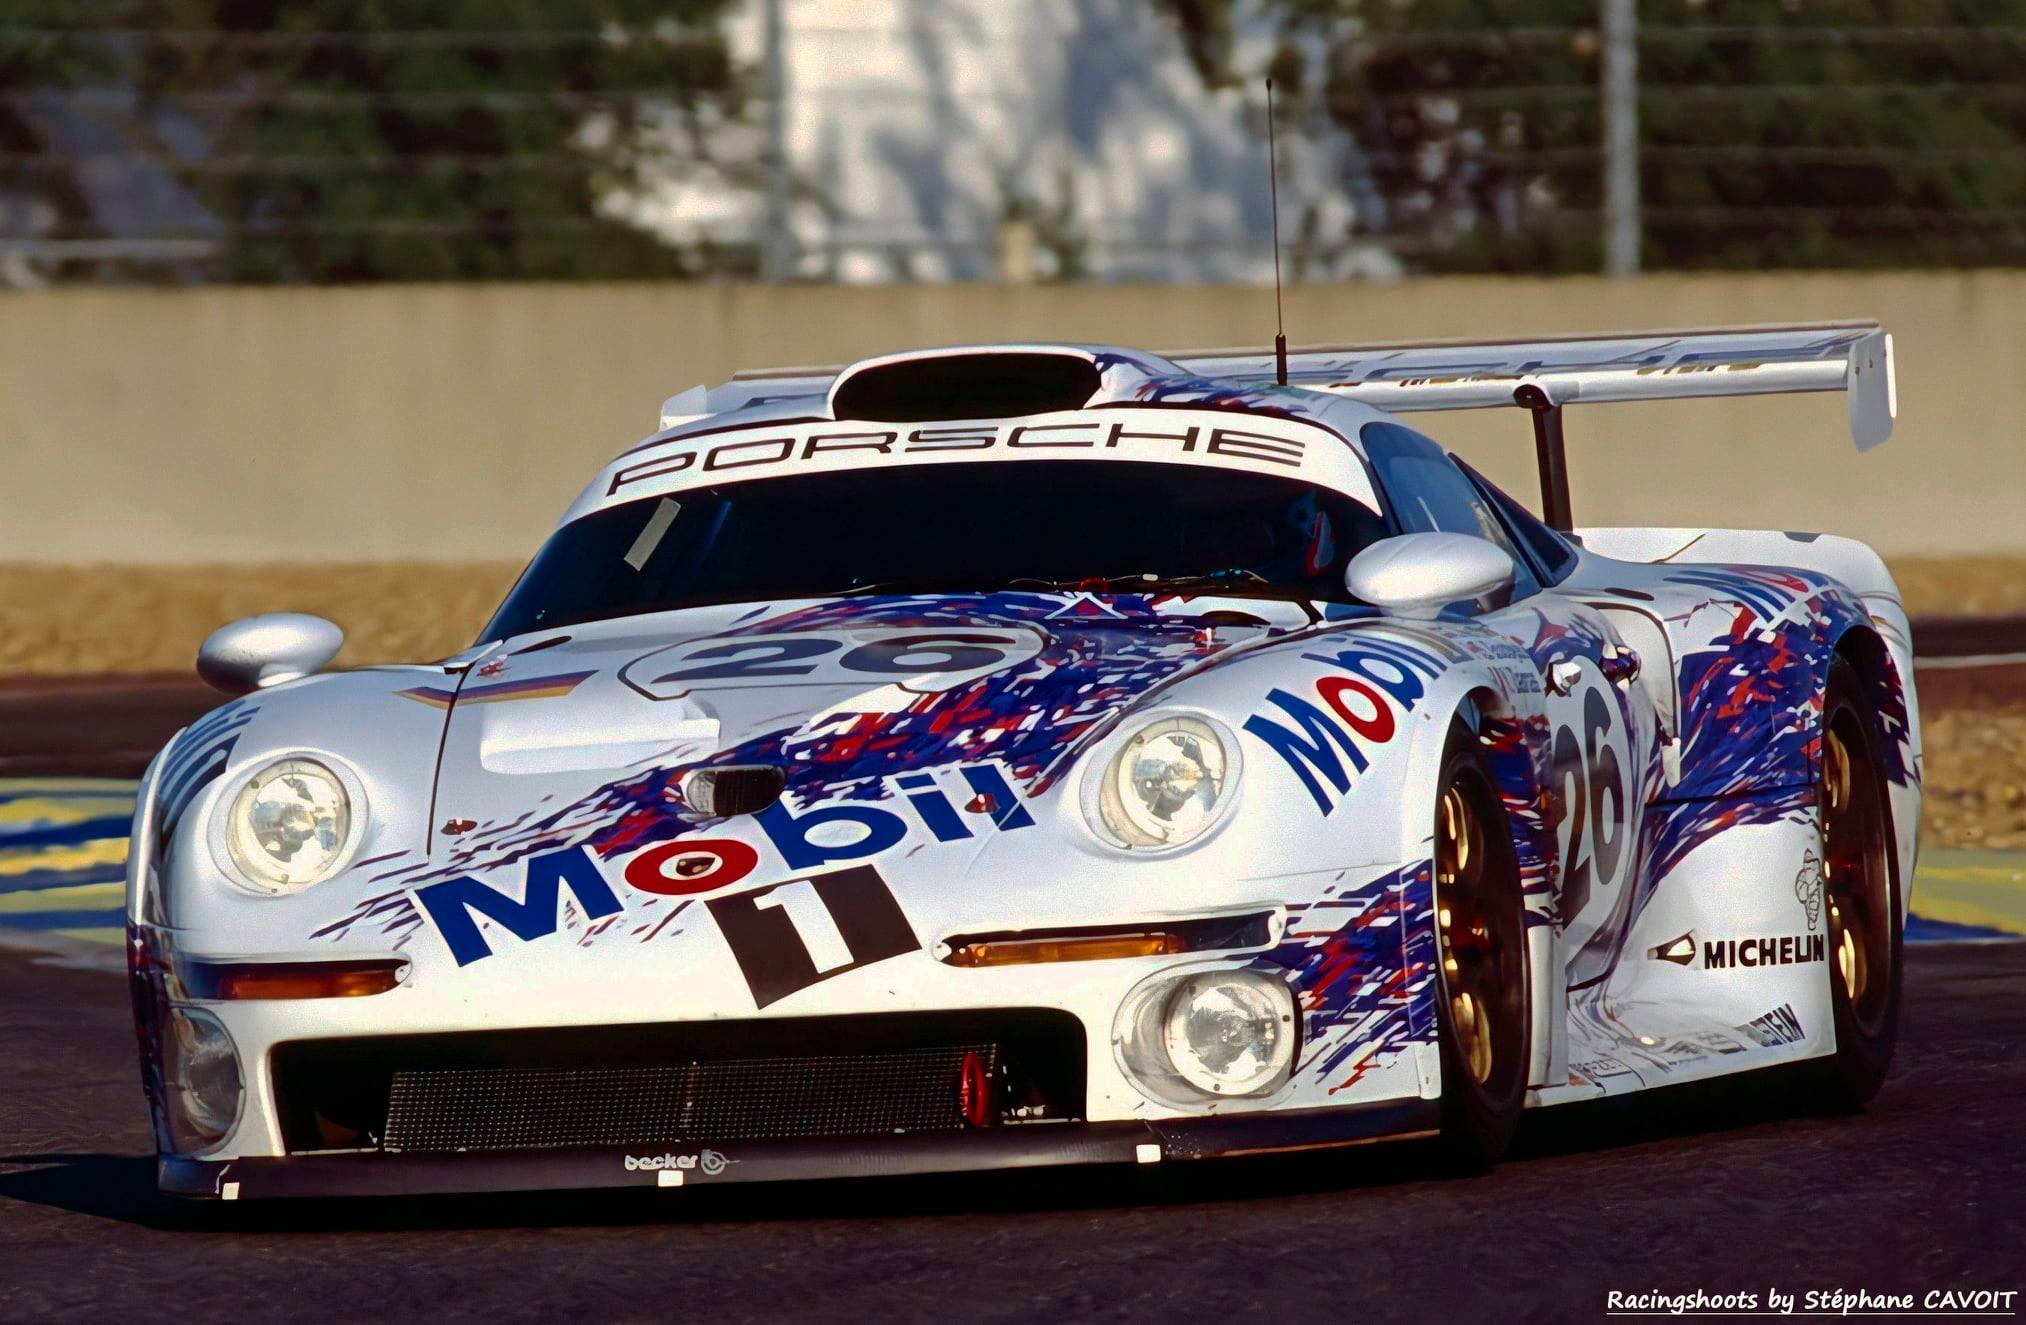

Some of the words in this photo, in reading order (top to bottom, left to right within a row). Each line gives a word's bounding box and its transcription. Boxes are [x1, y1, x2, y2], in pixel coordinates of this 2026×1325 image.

[607, 424, 1306, 497] PORSCHE
[651, 635, 1017, 684] 26
[1241, 633, 1448, 818] Mobil
[1553, 686, 1625, 930] 26
[414, 765, 1036, 968] Mobil
[1704, 934, 1824, 969] MICHELIN
[624, 1153, 698, 1171] becker
